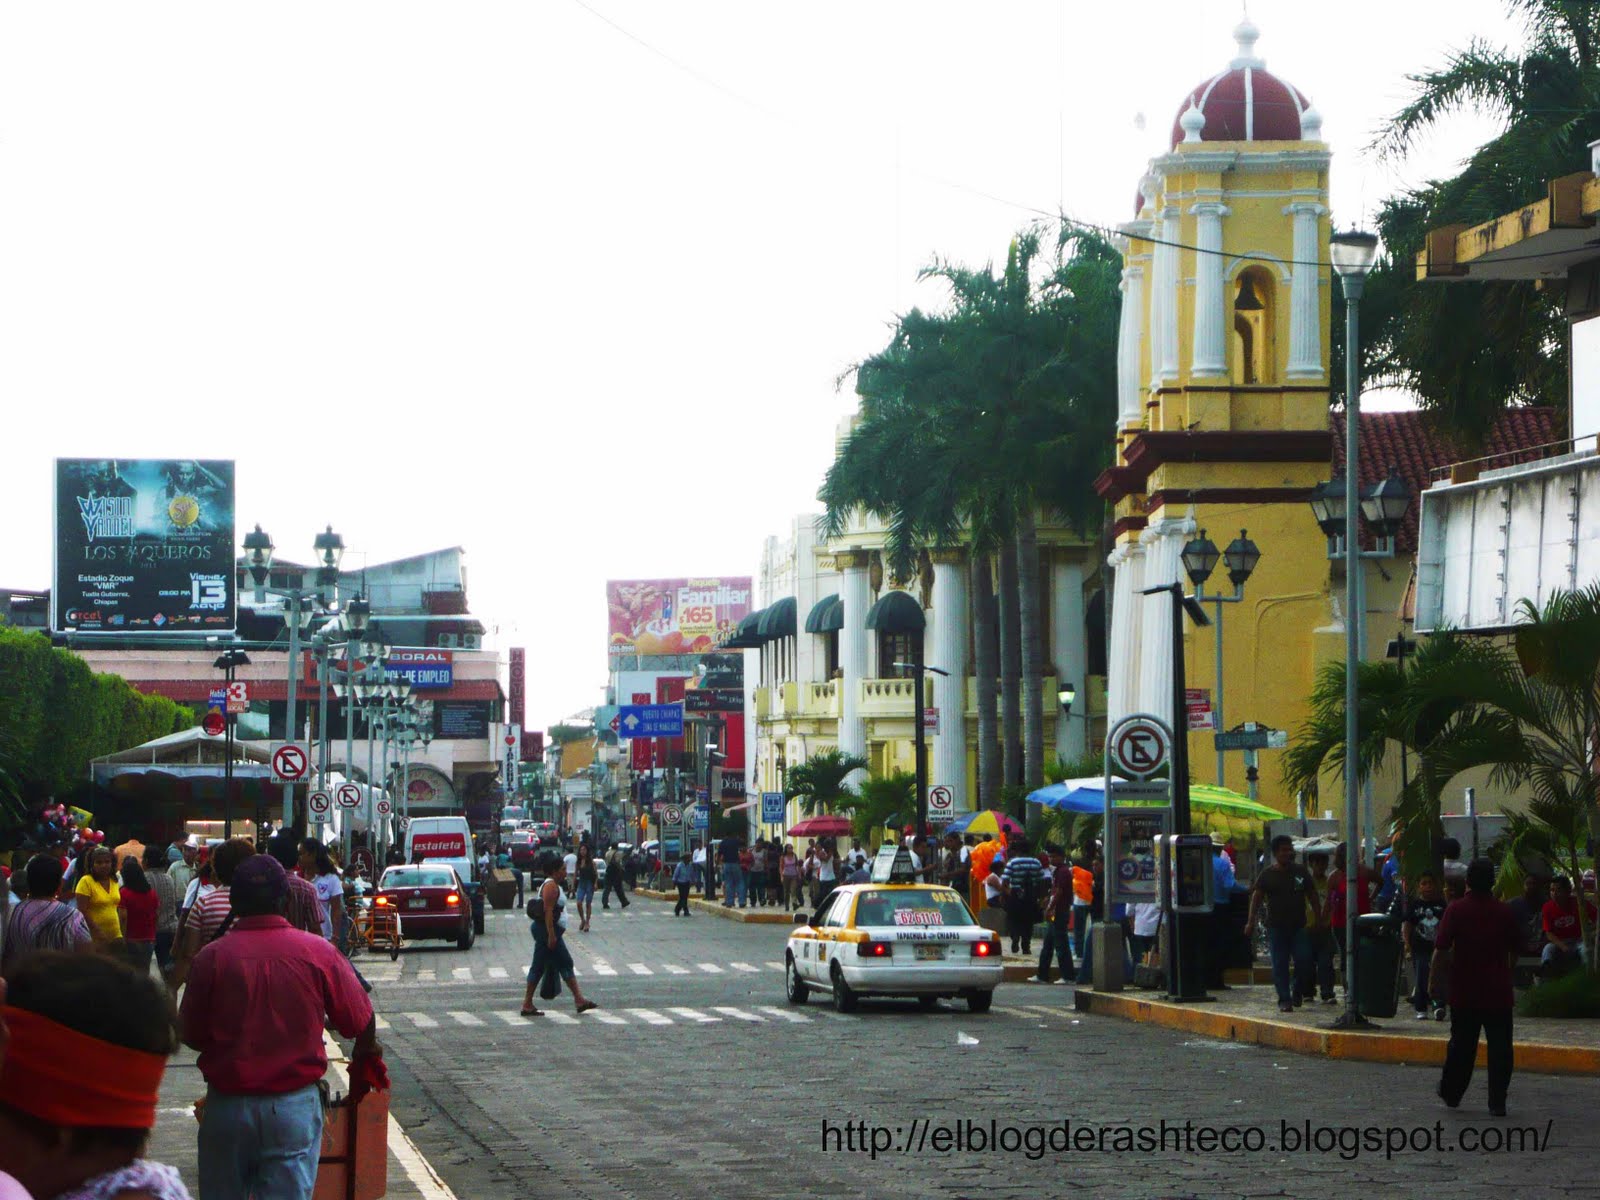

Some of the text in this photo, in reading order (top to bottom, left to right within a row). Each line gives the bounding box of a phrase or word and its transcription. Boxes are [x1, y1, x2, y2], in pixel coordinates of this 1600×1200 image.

[84, 545, 117, 560] LOS
[78, 574, 135, 584] Estadio Zoque
[192, 581, 227, 604] 13
[677, 585, 749, 605] Familiar
[418, 670, 450, 683] EMPLEO
[413, 841, 462, 851] estafeta
[896, 932, 928, 940] TAPACHULA
[936, 932, 960, 940] CHIAPAS
